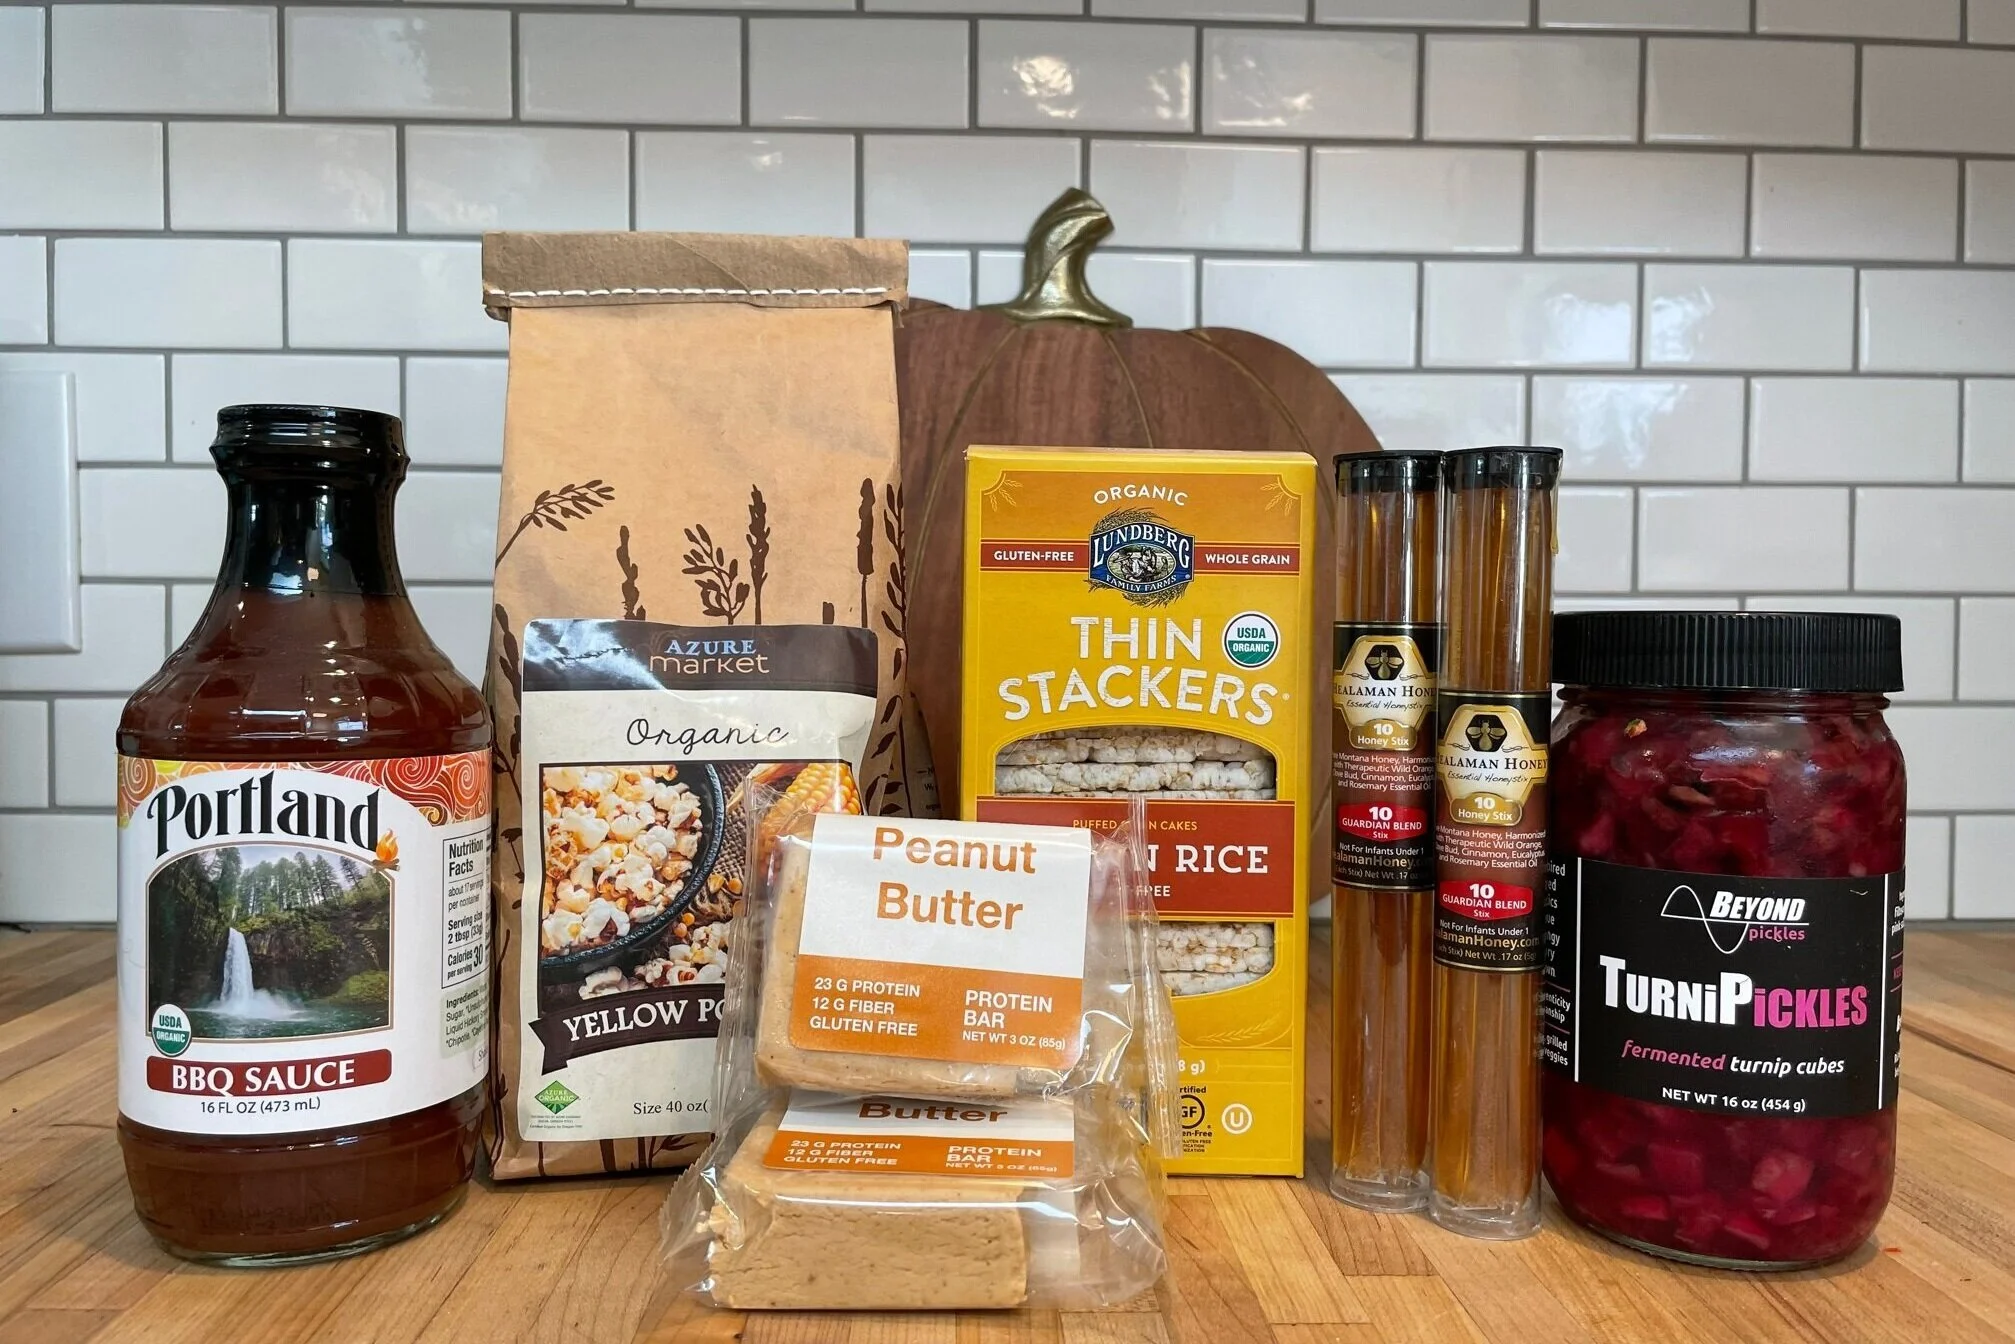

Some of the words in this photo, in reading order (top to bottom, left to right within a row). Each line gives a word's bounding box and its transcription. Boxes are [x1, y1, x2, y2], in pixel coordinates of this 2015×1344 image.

[1093, 484, 1189, 506] ORGANIC
[1093, 524, 1190, 569] LUNDBERG
[993, 550, 1075, 562] GLUTEN-FREE
[1205, 553, 1250, 565] WHOLE
[1252, 554, 1290, 565] GRAIN
[1106, 575, 1141, 592] FAMILY
[1145, 575, 1177, 591] FARMS
[1071, 616, 1202, 661] THIN
[1237, 627, 1266, 640] USDA
[664, 639, 756, 656] AZURE
[1232, 642, 1270, 654] ORGANIC
[649, 653, 770, 675] market
[998, 665, 1278, 725] STACKERS
[1346, 700, 1381, 709] Essential
[626, 718, 790, 756] Organic
[1373, 724, 1394, 736] 10
[1357, 735, 1389, 747] Honey
[1391, 736, 1409, 746] Stix
[1339, 753, 1370, 763] Montana
[1371, 755, 1401, 766] Honey,
[1344, 762, 1390, 773] Therapeutic
[1391, 765, 1411, 773] Wild
[1438, 754, 1499, 769] EALAMAN
[1504, 757, 1548, 771] HONEY
[1361, 773, 1406, 783] Cinnamon,
[1447, 770, 1482, 782] Essential
[1349, 781, 1388, 792] Rosemary
[1390, 783, 1422, 791] Essential
[1474, 796, 1496, 809] 10
[147, 770, 380, 860] Portland
[1368, 806, 1393, 821] 10
[1458, 808, 1490, 822] Honey
[1493, 811, 1513, 821] Stix
[1072, 819, 1118, 830] PUFFED
[1160, 821, 1198, 831] CAKES
[1342, 817, 1390, 831] GUARDIAN
[1393, 821, 1422, 831] BLEND
[1372, 830, 1389, 839] Stix
[1440, 825, 1470, 837] Montana
[1472, 829, 1503, 841] Honey,
[449, 838, 484, 860] Nutrition
[1340, 842, 1350, 852] Not
[1351, 844, 1363, 853] For
[1365, 844, 1394, 855] Infants
[1395, 846, 1419, 856] Under
[1445, 835, 1492, 849] Therapeutic
[1493, 840, 1514, 849] Wild
[873, 826, 1037, 875] Peanut
[1461, 847, 1510, 860] Cinnamon,
[1175, 844, 1269, 874] RICE
[1449, 855, 1489, 868] Rosemary
[1491, 859, 1527, 868] Essential
[1528, 859, 1538, 868] Oil
[449, 858, 474, 877] Facts
[448, 885, 463, 897] about
[1469, 883, 1495, 899] 10
[448, 900, 458, 913] per
[877, 881, 1023, 931] Butter
[1442, 893, 1492, 909] GUARDIAN
[1495, 900, 1527, 910] BLEND
[1709, 890, 1806, 921] BEYOND
[1473, 909, 1490, 918] Stix
[448, 915, 473, 931] Serving
[1440, 919, 1451, 930] Not
[1451, 922, 1463, 931] For
[1465, 924, 1496, 936] Infants
[1497, 927, 1523, 936] Under
[447, 933, 453, 945] 2
[455, 930, 470, 943] tbsp
[1749, 926, 1805, 943] pickles
[447, 948, 473, 967] Calories
[473, 943, 483, 968] 30
[1465, 949, 1480, 960] Net
[447, 968, 456, 981] per
[457, 964, 473, 978] serving
[814, 977, 832, 990] 23
[836, 979, 848, 992] G
[852, 980, 921, 998] PROTEIN
[812, 997, 829, 1010] 12
[833, 998, 845, 1011] G
[849, 999, 895, 1015] FIBER
[965, 989, 1053, 1013] PROTEIN
[159, 1014, 182, 1030] USDA
[563, 1000, 688, 1042] YELLOW
[810, 1015, 874, 1034] GLUTEN
[877, 1020, 918, 1037] FREE
[963, 1009, 1005, 1029] BAR
[446, 1021, 464, 1036] Liquid
[156, 1030, 186, 1044] ORGANIC
[962, 1030, 986, 1042] NET
[988, 1032, 1007, 1044] WT
[1009, 1035, 1017, 1045] 3
[1019, 1035, 1036, 1047] OZ
[1038, 1037, 1066, 1052] (85g)
[1622, 1039, 1726, 1071] fermented
[1730, 1055, 1792, 1078] turnip
[1796, 1057, 1844, 1074] cubes
[172, 1063, 235, 1097] BBQ
[245, 1059, 356, 1092] SAUCE
[1180, 1086, 1207, 1094] rtified
[201, 1100, 215, 1114] 16
[218, 1101, 233, 1114] FL
[236, 1100, 257, 1114] OZ
[260, 1098, 291, 1115] (473
[294, 1097, 321, 1112] mL)
[1662, 1087, 1690, 1102] NET
[1694, 1091, 1718, 1106] WT
[1722, 1095, 1737, 1108] 16
[1741, 1099, 1758, 1110] oz
[1761, 1096, 1790, 1112] (454
[1793, 1098, 1806, 1113] g)
[633, 1101, 662, 1116] Size
[666, 1102, 682, 1114] 40
[859, 1102, 1008, 1122] Butter
[791, 1140, 810, 1148] 23
[830, 1142, 901, 1150] PROTEIN
[948, 1145, 1042, 1157] PROTEIN
[783, 1156, 851, 1164] GLUTEN
[854, 1157, 898, 1165] FREE
[946, 1154, 992, 1163] BAR
